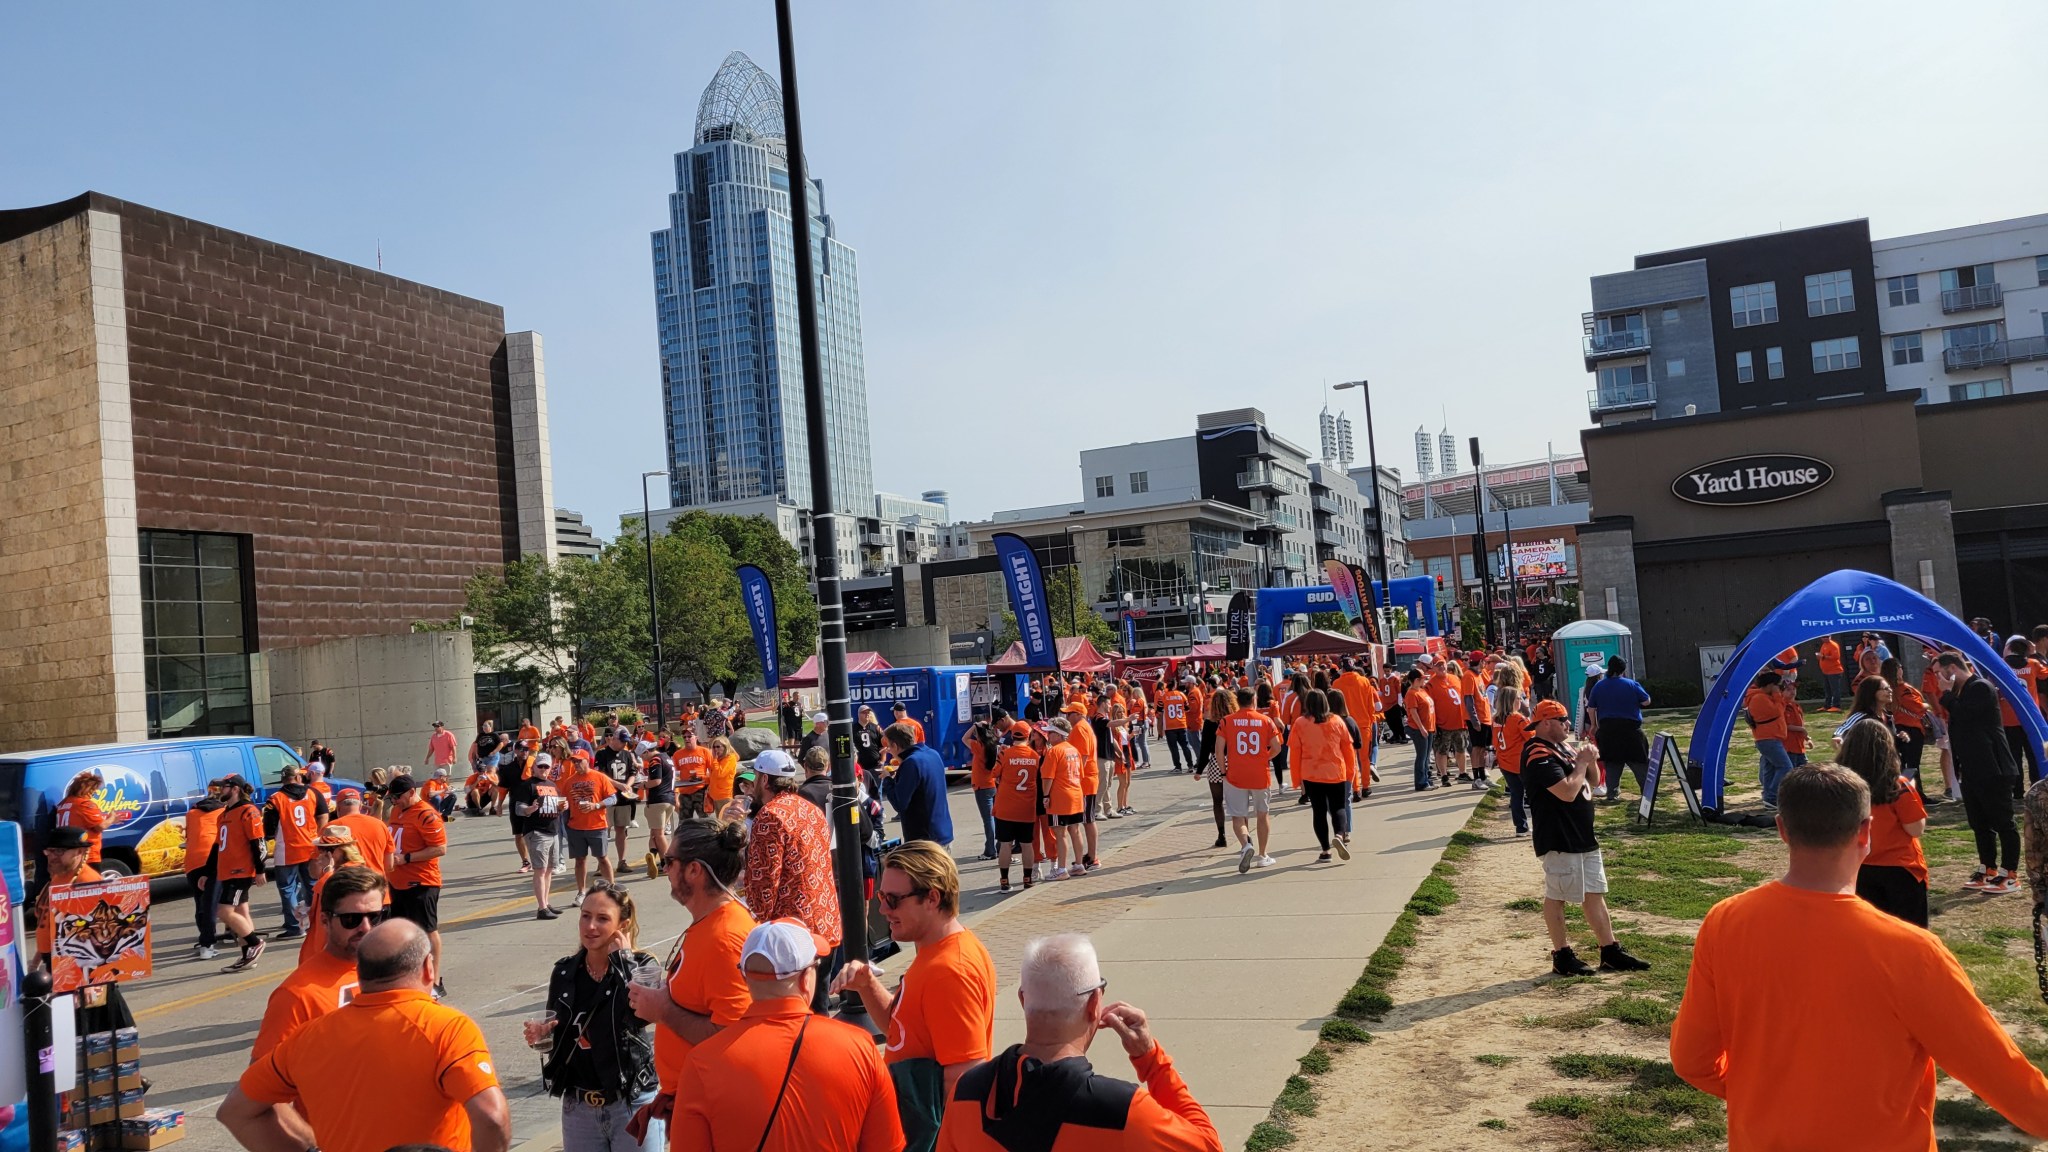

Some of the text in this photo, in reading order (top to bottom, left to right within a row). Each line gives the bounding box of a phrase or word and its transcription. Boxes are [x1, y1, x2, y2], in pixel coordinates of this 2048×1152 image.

[1690, 466, 1819, 495] Yard House
[1511, 545, 1557, 555] GAMEDAY
[1522, 552, 1549, 564] Party
[1354, 569, 1369, 608] TATTOOS
[1011, 556, 1043, 653] BUD LIGHT
[1307, 592, 1335, 603] BUD
[751, 584, 768, 633] LIGHT
[1801, 613, 1914, 627] FIFTH THIRD BANK
[1538, 664, 1545, 674] 5
[848, 685, 915, 701] UD LIGHT
[1384, 684, 1391, 697] 9
[1448, 687, 1461, 706] 9
[794, 706, 800, 717] 9
[1167, 703, 1183, 719] 85
[1233, 718, 1248, 727] YOUR
[861, 732, 871, 748] 9
[1236, 731, 1260, 755] 69
[1497, 731, 1507, 750] 9
[610, 762, 627, 780] 12
[1015, 768, 1029, 791] 2
[89, 788, 142, 815] Skyline
[294, 805, 306, 827] 9
[219, 824, 228, 852] 9
[52, 892, 69, 901] NEW
